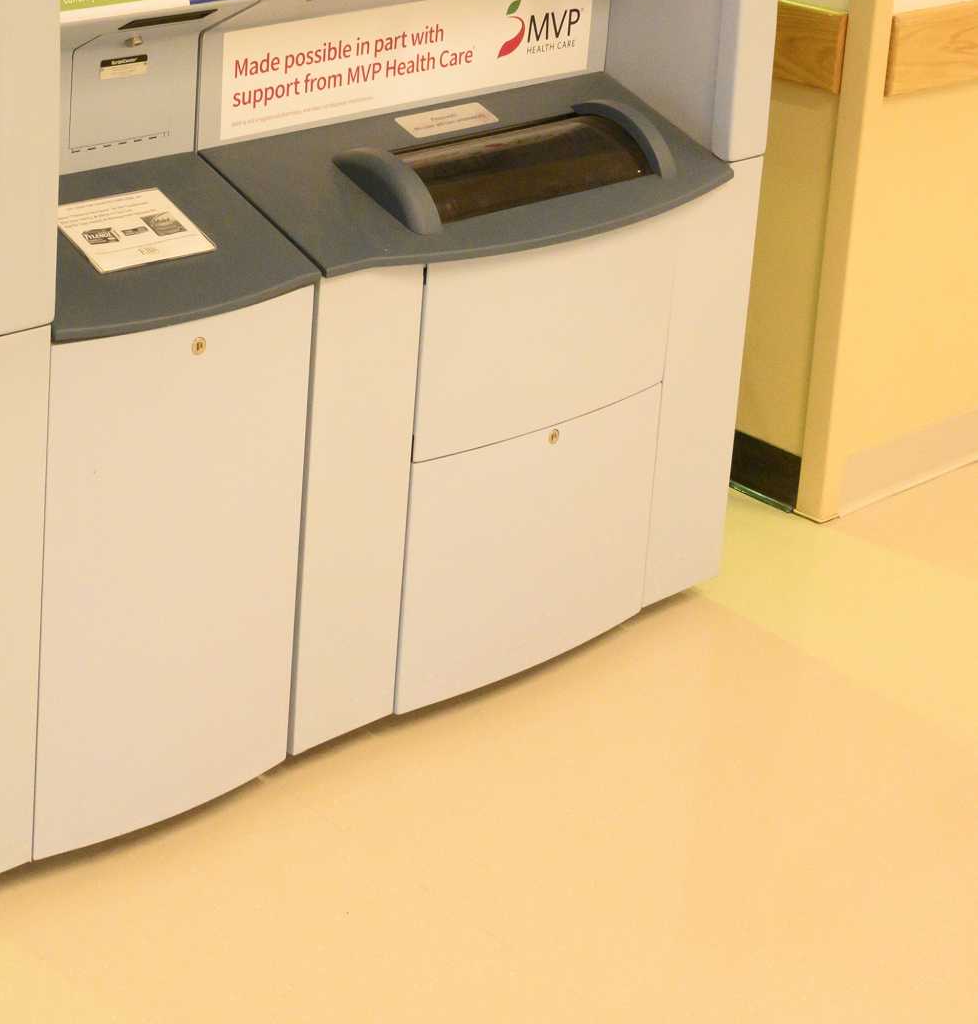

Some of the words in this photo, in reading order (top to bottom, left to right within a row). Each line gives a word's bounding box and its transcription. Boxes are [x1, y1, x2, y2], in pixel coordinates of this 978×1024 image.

[526, 44, 555, 55] HEALTH
[556, 40, 575, 50] CARE
[527, 7, 580, 43] MVP
[234, 52, 281, 78] Made
[284, 40, 352, 69] possible
[356, 37, 371, 57] in
[374, 34, 407, 59] part
[411, 24, 445, 47] with
[232, 79, 301, 108] support
[304, 70, 343, 93] from
[346, 61, 382, 87] MVP
[385, 56, 436, 78] Health
[439, 48, 474, 69] Care
